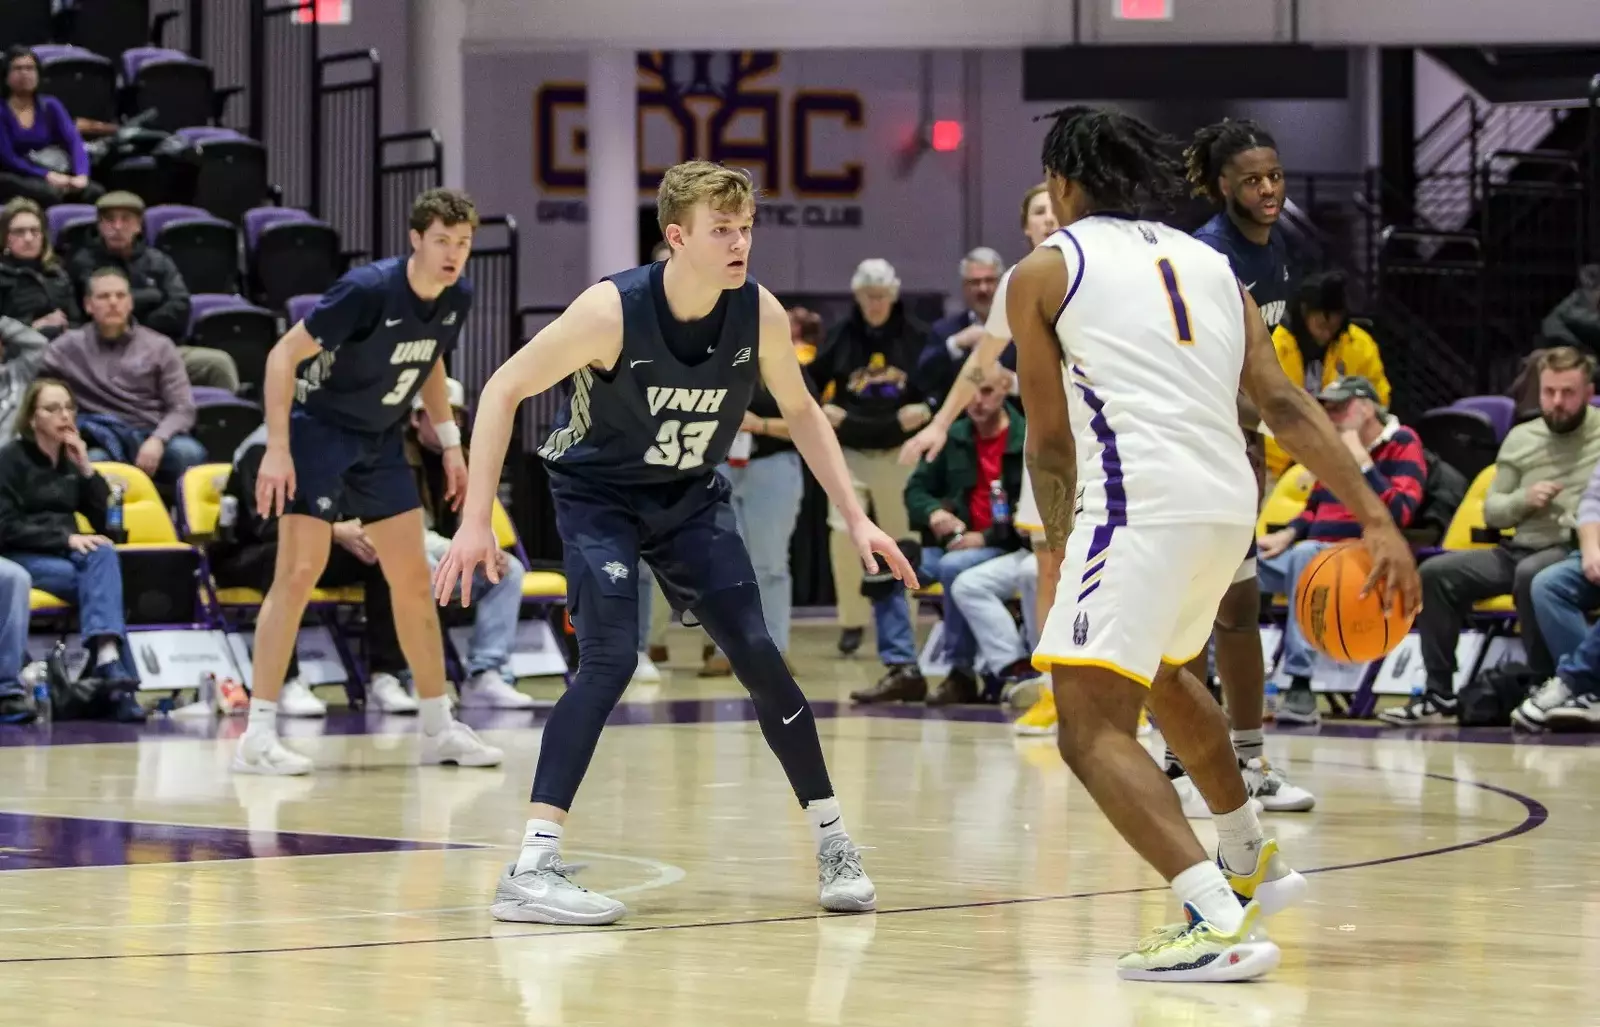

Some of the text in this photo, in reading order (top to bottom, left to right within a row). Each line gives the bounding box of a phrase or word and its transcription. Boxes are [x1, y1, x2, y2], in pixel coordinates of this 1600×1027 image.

[1155, 256, 1194, 346] 1
[390, 339, 437, 365] UNH
[381, 368, 420, 405] 3
[646, 386, 728, 417] UNH
[643, 419, 719, 470] 33
